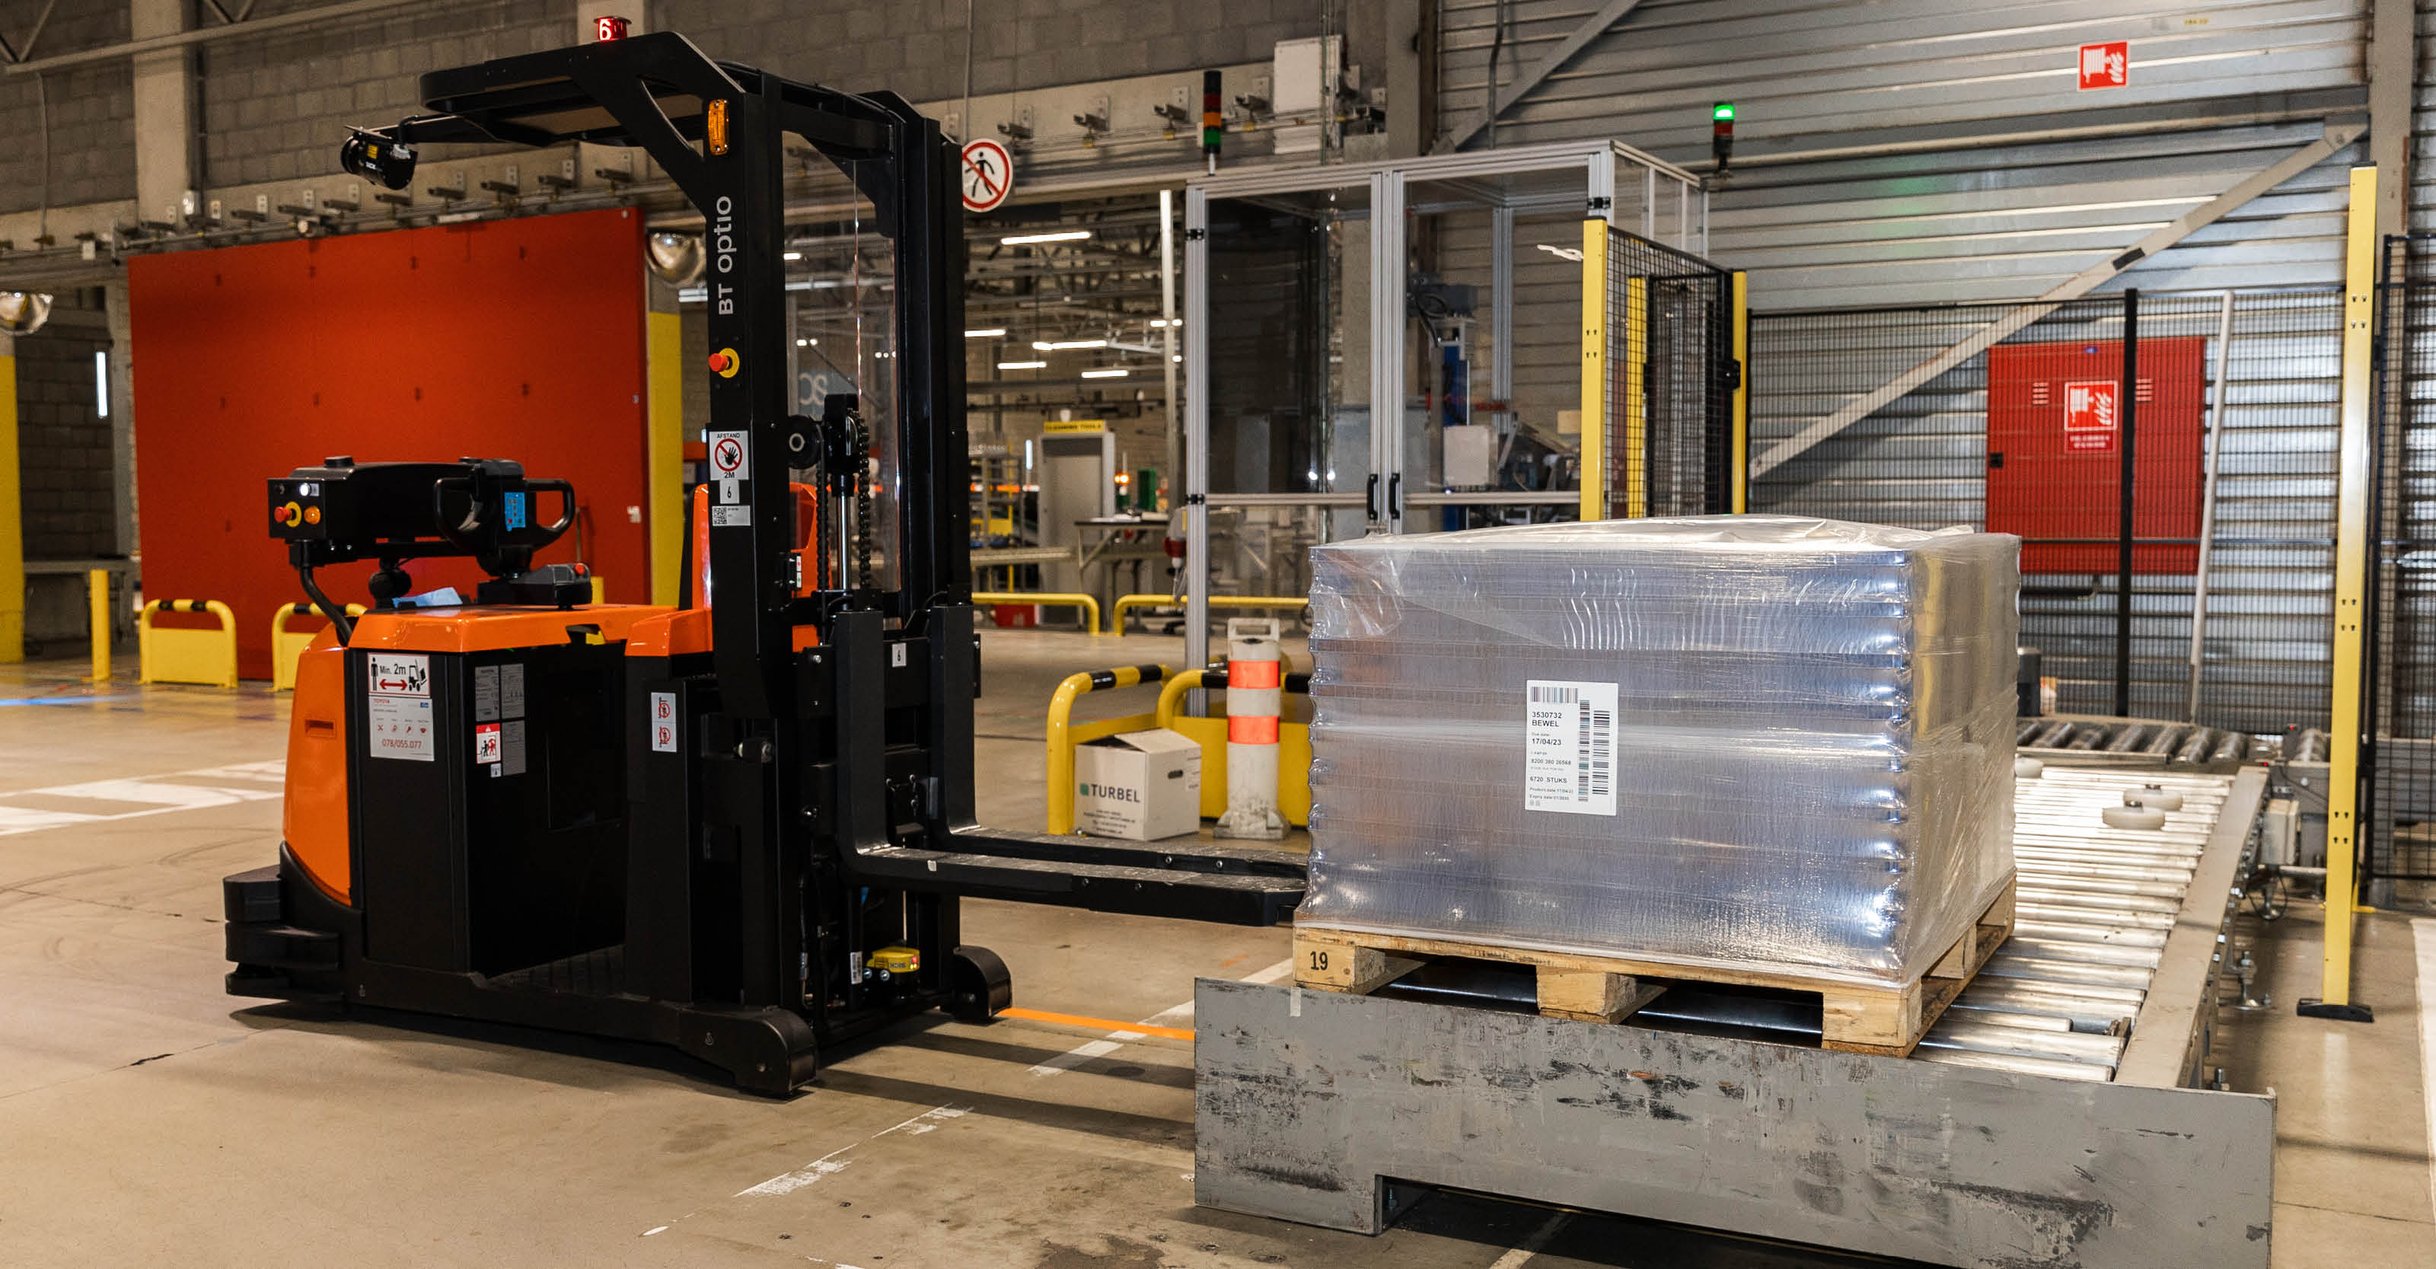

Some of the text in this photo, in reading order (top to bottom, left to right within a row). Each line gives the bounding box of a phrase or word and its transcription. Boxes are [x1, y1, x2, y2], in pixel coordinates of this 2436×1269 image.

[600, 18, 612, 41] 6
[718, 283, 734, 315] BT
[724, 471, 735, 479] 2M
[727, 486, 732, 499] 6
[393, 663, 407, 675] 2m
[1531, 711, 1562, 719] 3530732
[1531, 720, 1559, 728] BEWEL
[1531, 738, 1562, 746] 17/04/23
[1091, 784, 1141, 804] TURBEL
[1310, 951, 1329, 971] 19
